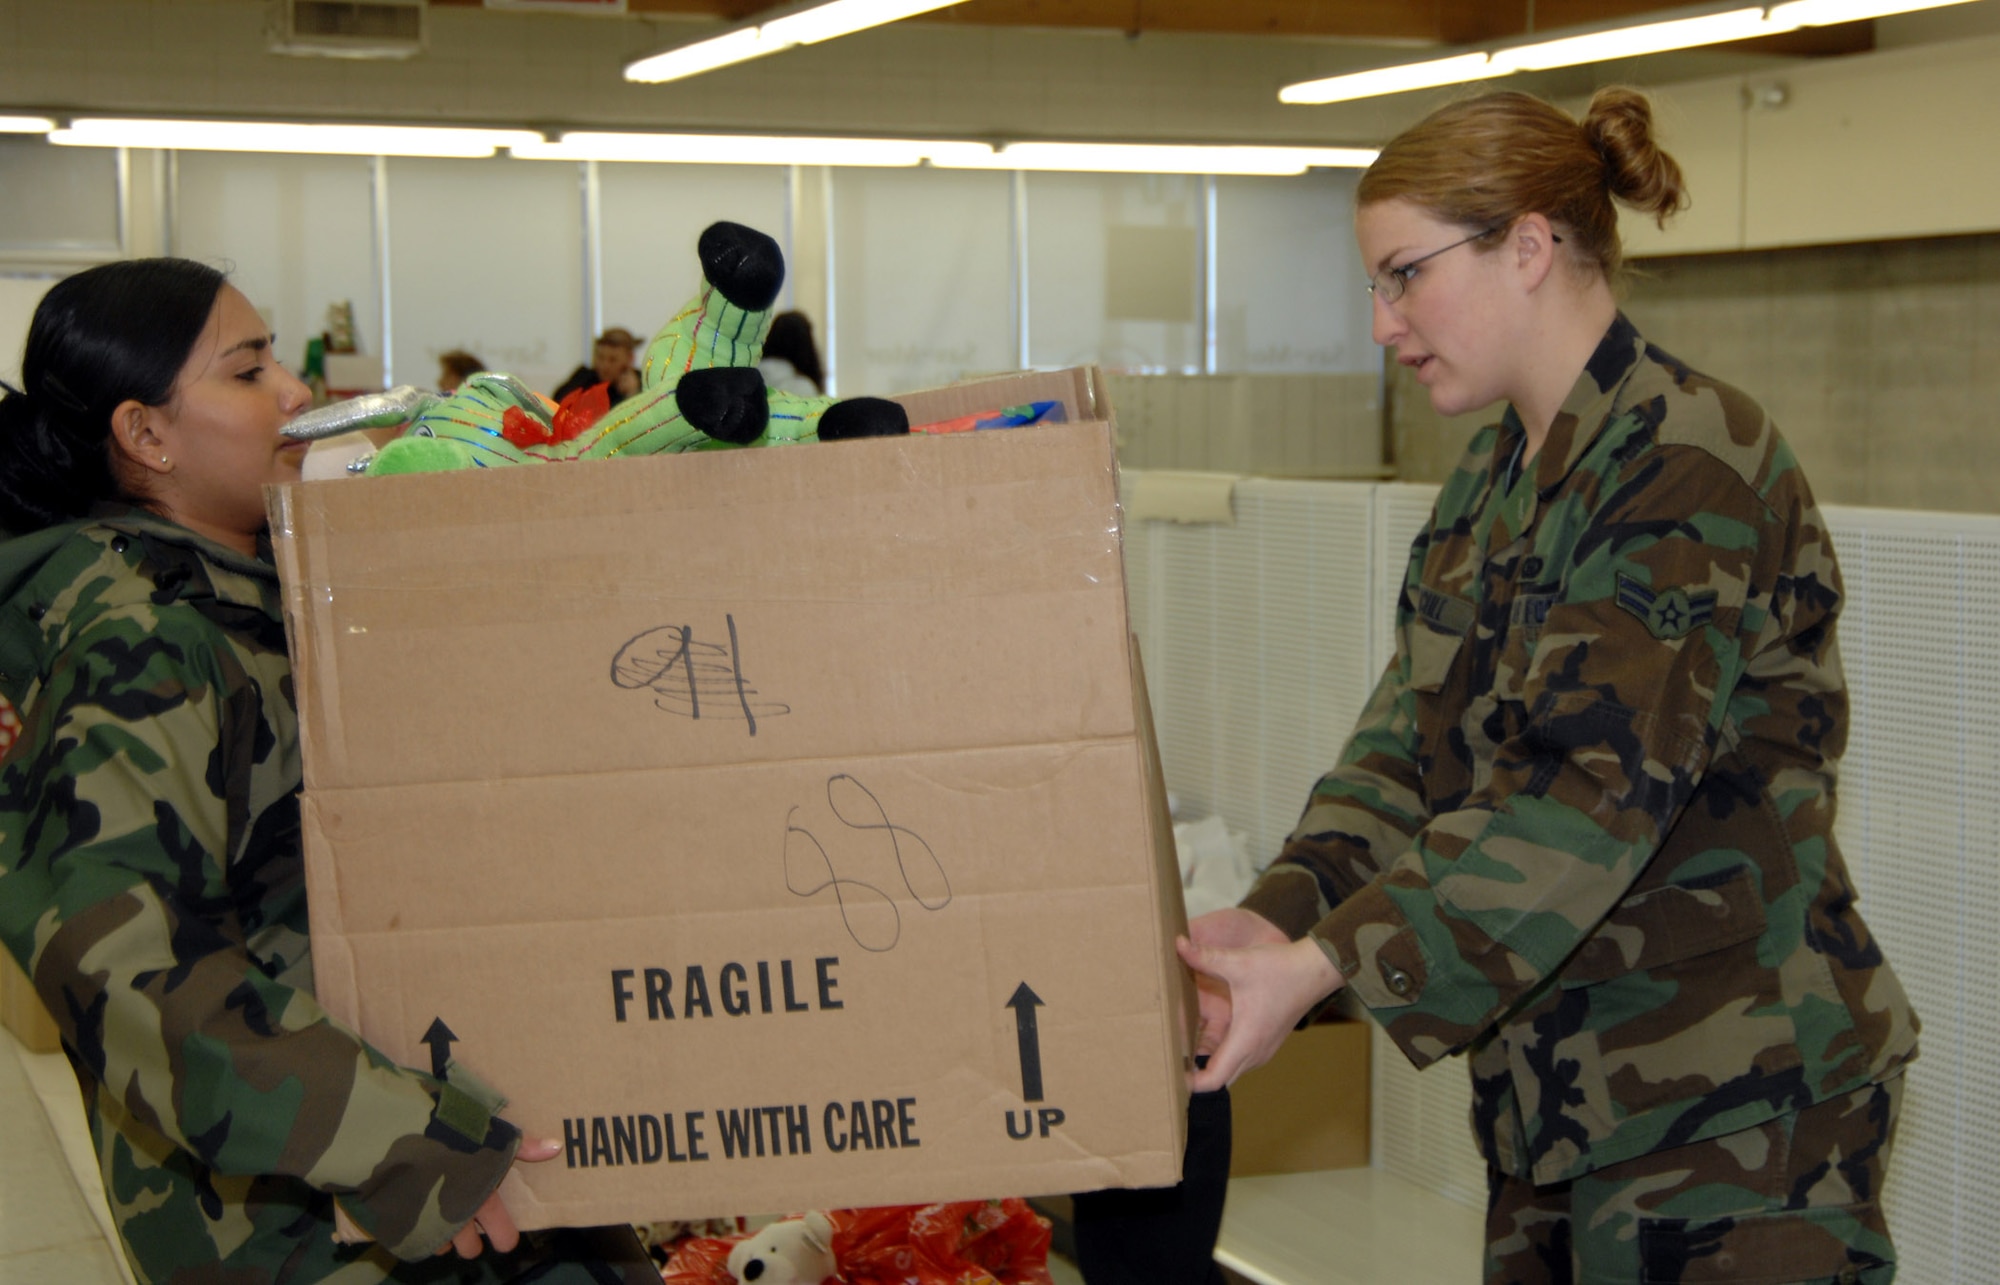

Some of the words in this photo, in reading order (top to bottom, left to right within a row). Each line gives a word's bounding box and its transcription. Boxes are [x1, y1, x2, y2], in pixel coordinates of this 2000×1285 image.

[612, 957, 844, 1022] FRAGILE
[563, 1111, 709, 1169] HANDLE
[715, 1104, 811, 1159] WITH
[823, 1097, 921, 1152] CARE
[1005, 1108, 1066, 1140] UP
